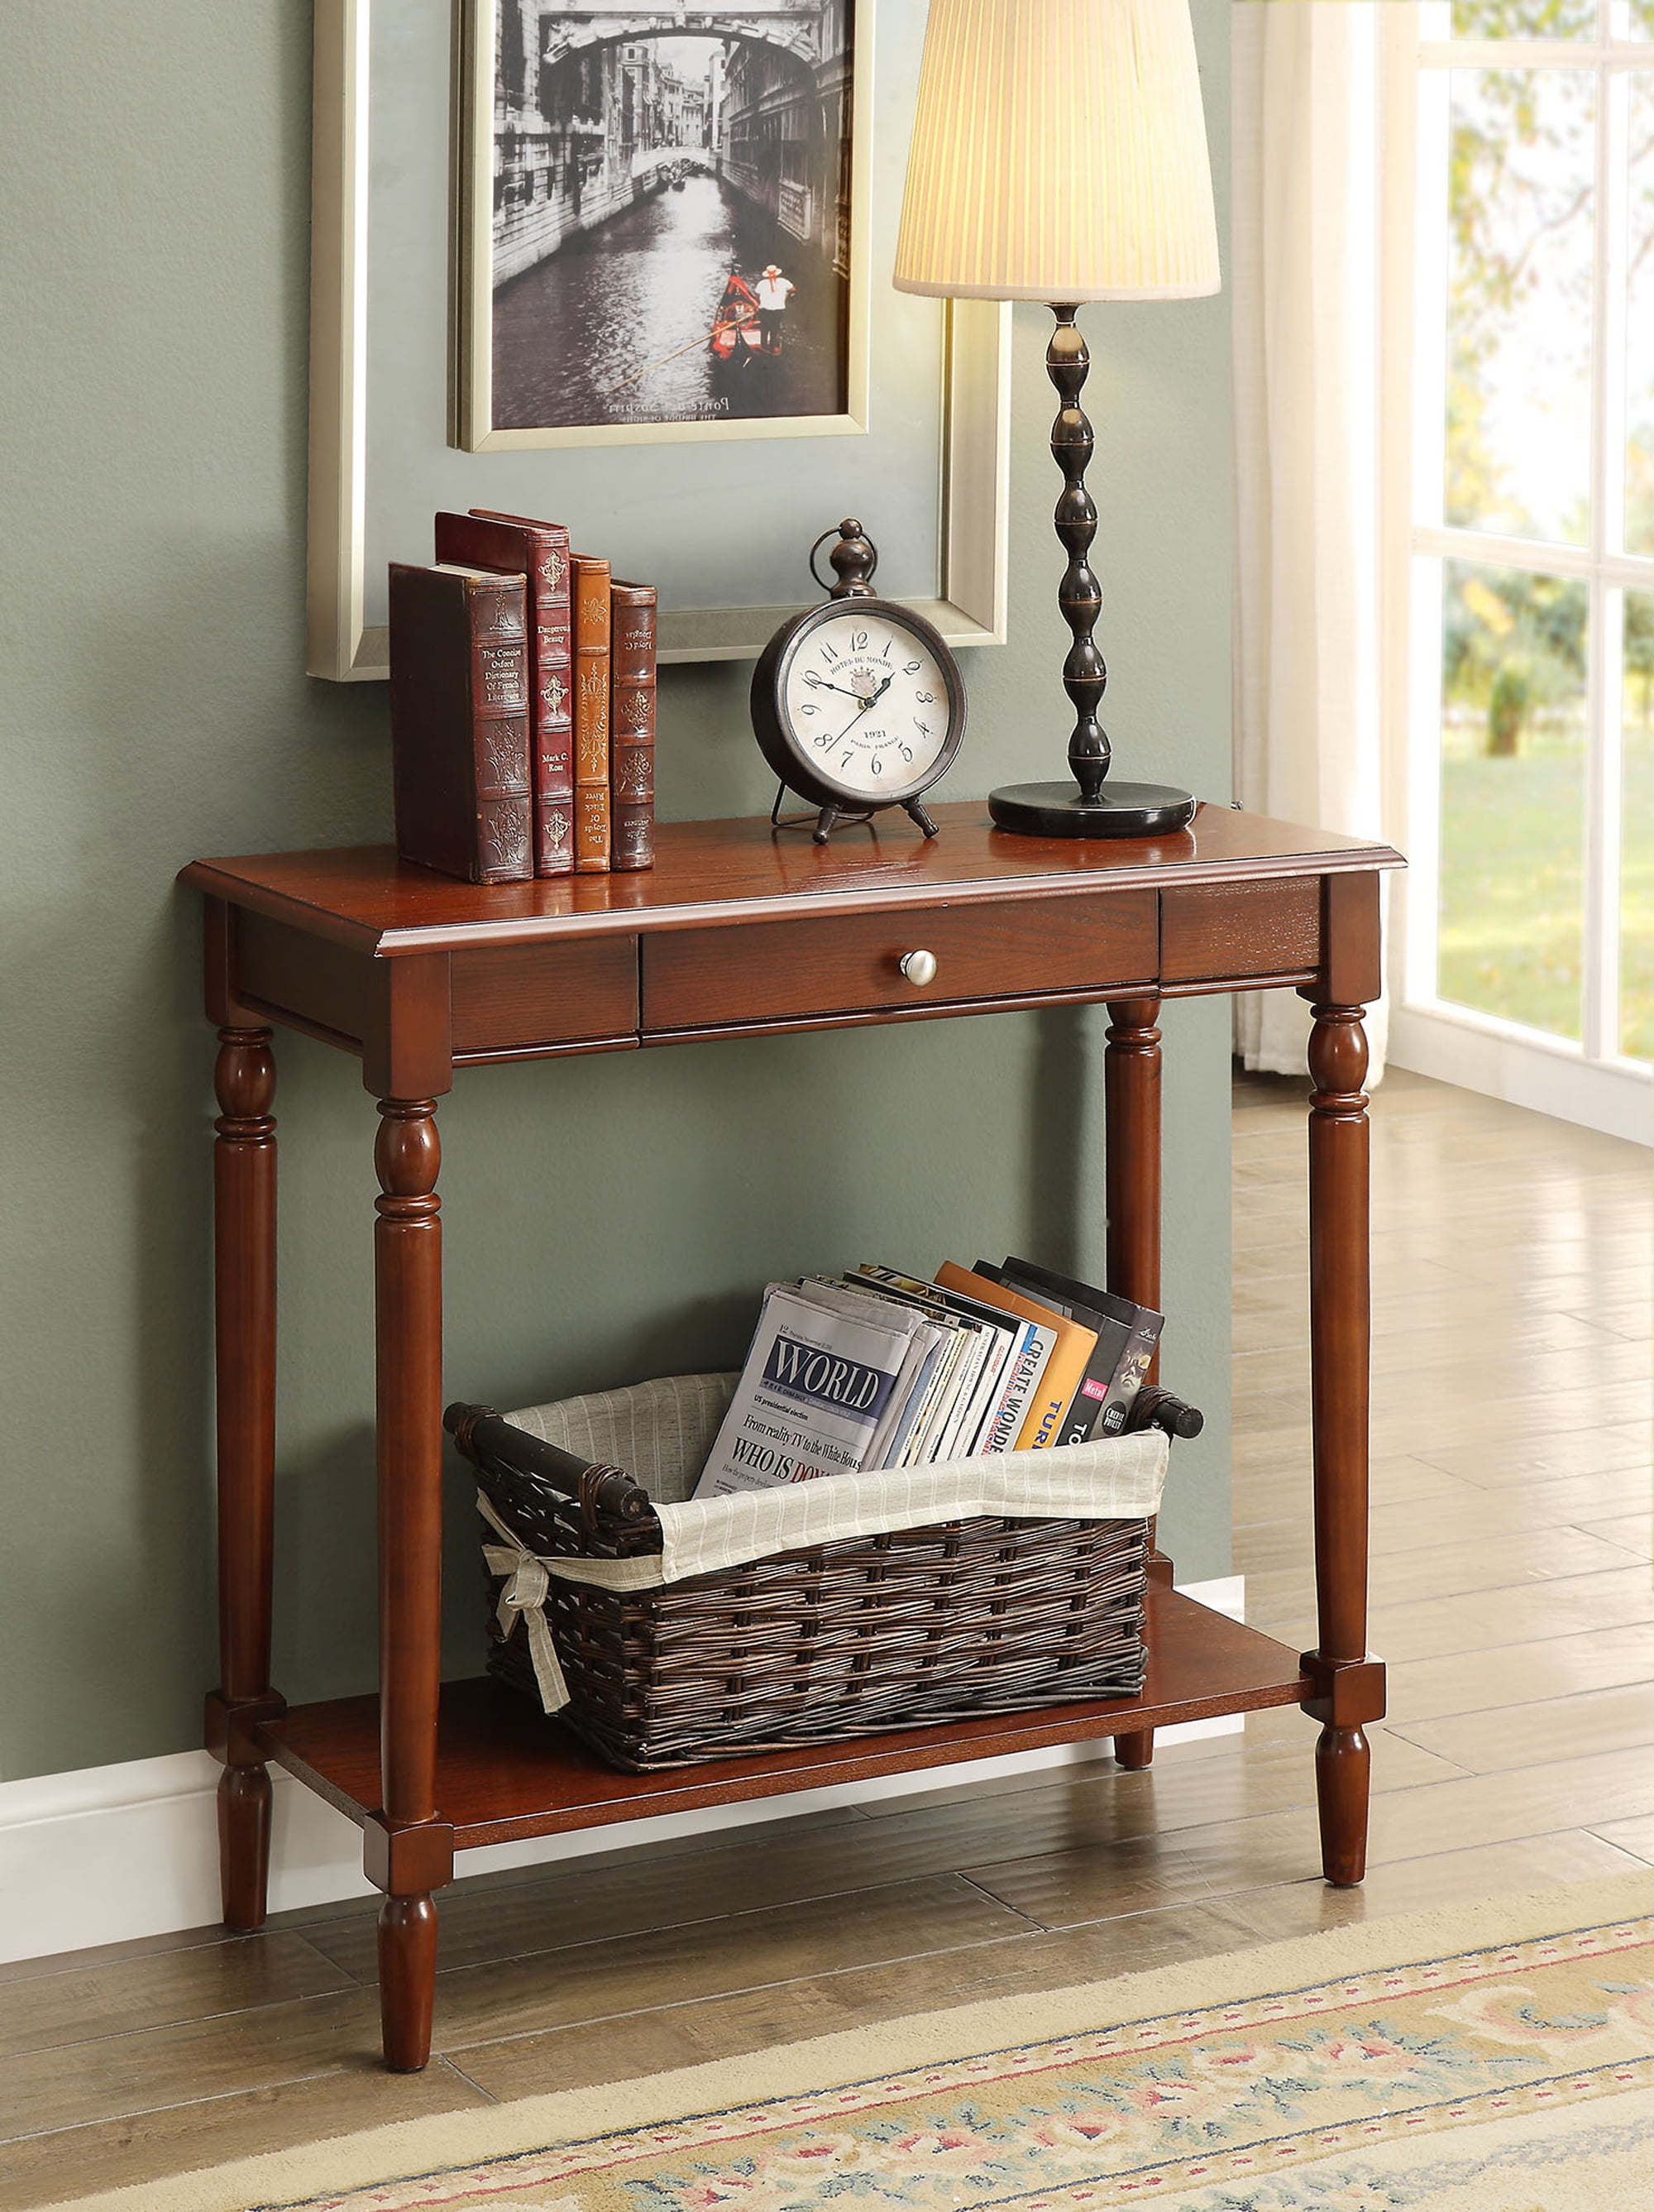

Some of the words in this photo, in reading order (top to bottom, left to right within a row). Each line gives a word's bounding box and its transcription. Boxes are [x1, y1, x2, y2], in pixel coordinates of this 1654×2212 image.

[851, 631, 868, 652] 12
[882, 637, 894, 657] 1
[820, 642, 838, 663] 11
[829, 658, 853, 675] HOTEL
[867, 657, 893, 670] MONDE
[903, 659, 923, 676] 2
[802, 670, 822, 690] 10
[915, 691, 934, 704] 3
[800, 704, 822, 716] 9
[863, 730, 887, 739] 1921
[913, 716, 930, 738] 4
[814, 733, 833, 747] 8
[840, 749, 853, 768] 7
[897, 741, 913, 762] 5
[871, 753, 882, 775] 6
[780, 1324, 789, 1334] 12
[776, 1340, 879, 1410] WORLD
[1015, 1340, 1044, 1394] CREATE
[1085, 1381, 1106, 1398] Metal
[762, 1399, 790, 1414] presidential
[791, 1410, 808, 1420] election
[981, 1414, 1002, 1456] MACHI
[990, 1398, 1023, 1454] WONDE
[744, 1415, 766, 1432] From
[767, 1424, 791, 1446] reality
[792, 1434, 804, 1449] TV
[804, 1440, 811, 1451] to
[811, 1441, 822, 1455] the
[823, 1445, 841, 1463] White
[732, 1438, 775, 1472] WHO
[774, 1454, 794, 1479] IS
